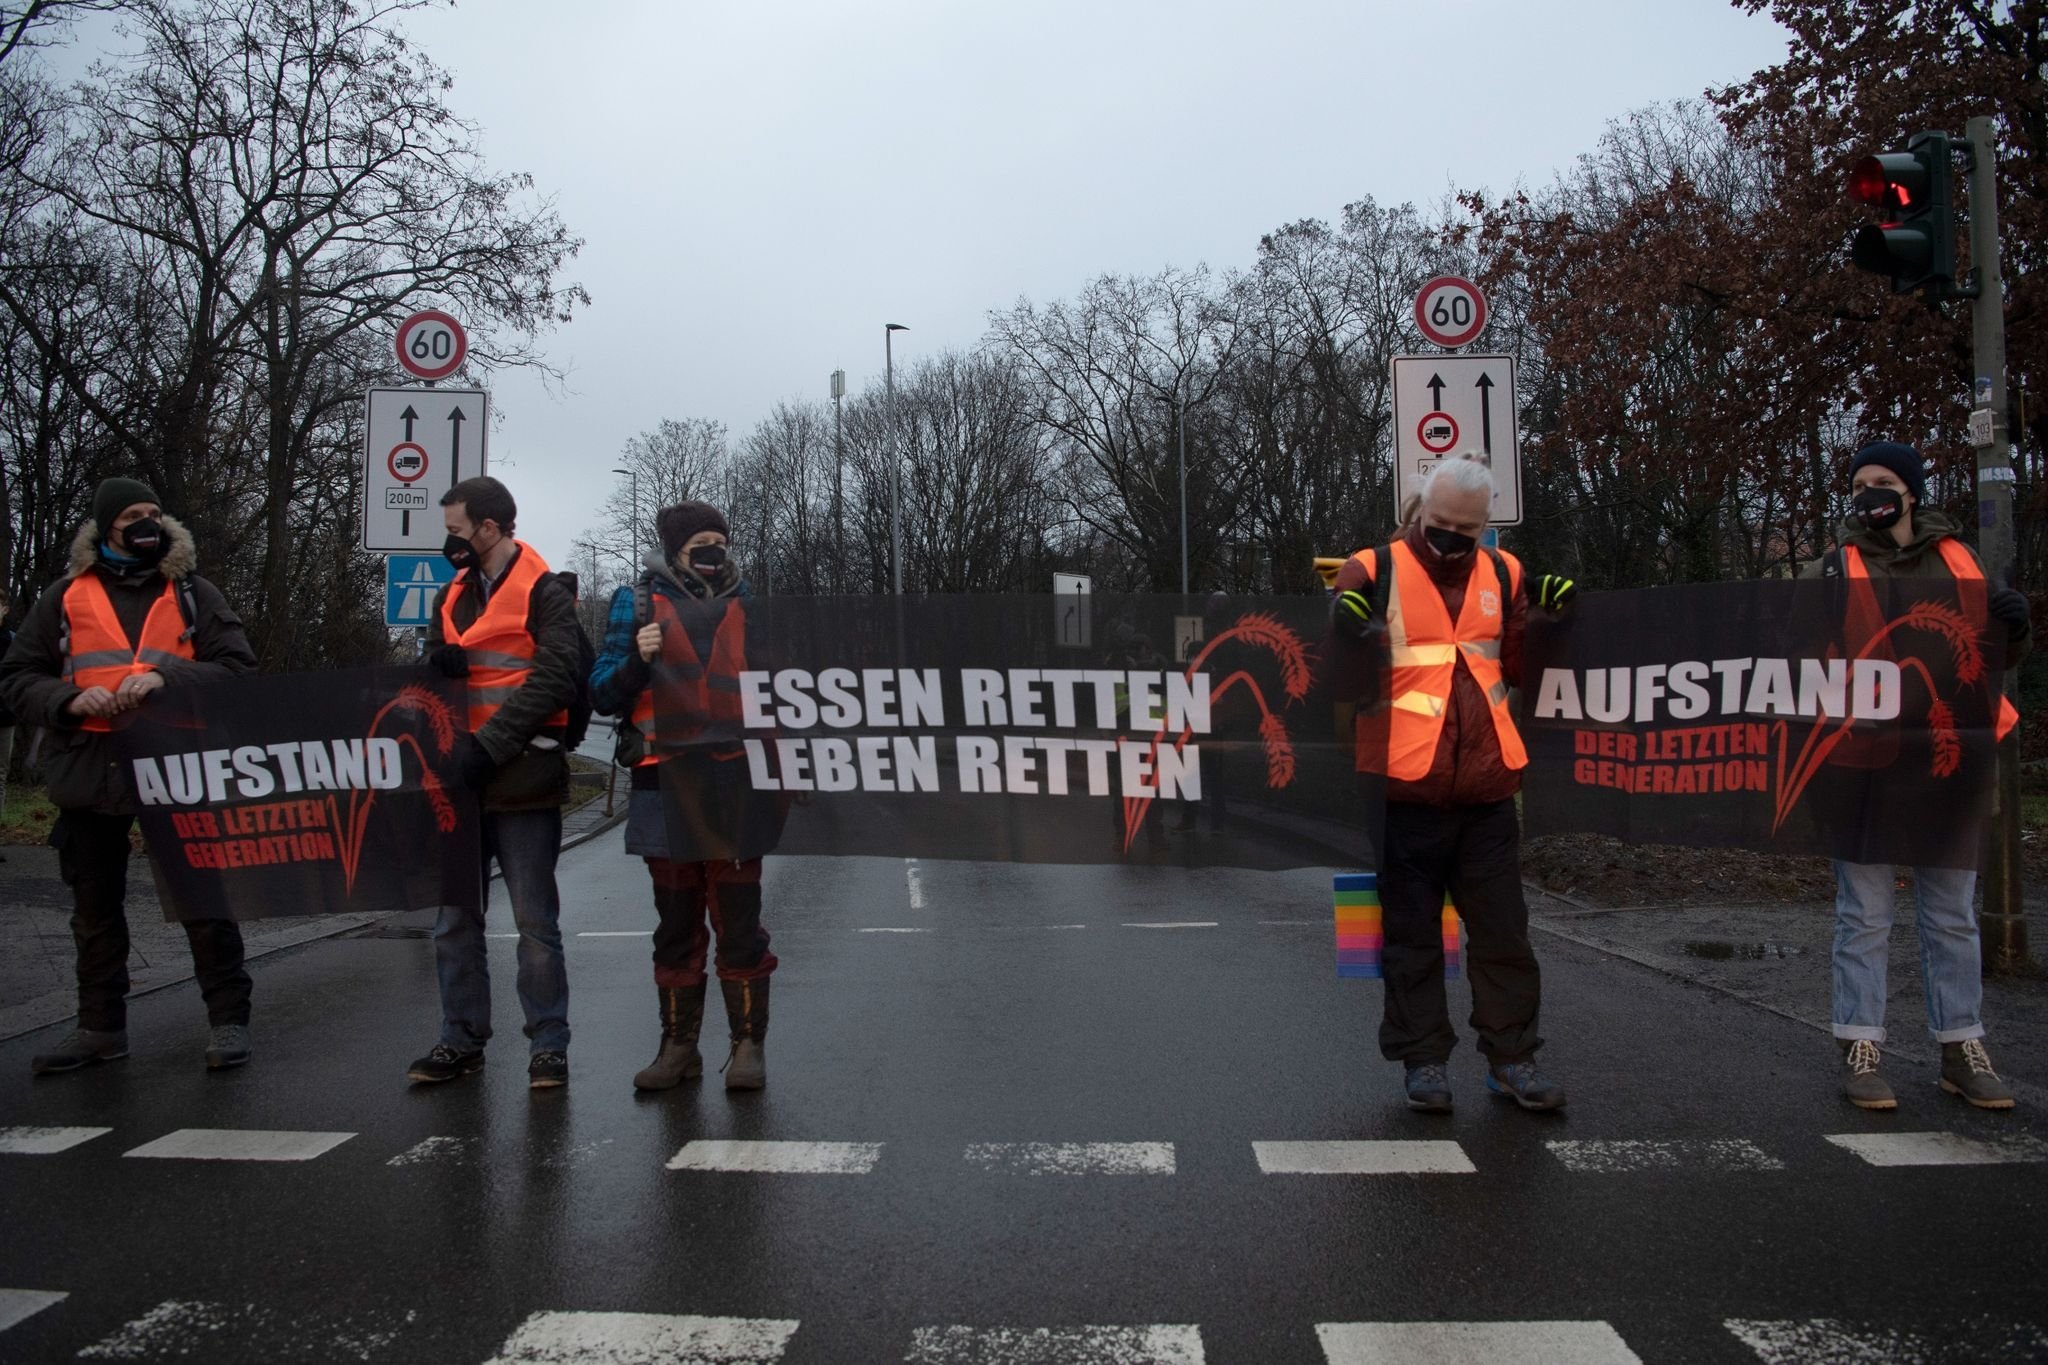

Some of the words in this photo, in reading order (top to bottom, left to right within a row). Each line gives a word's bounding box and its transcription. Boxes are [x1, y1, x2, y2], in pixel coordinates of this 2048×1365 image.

[1431, 296, 1470, 326] 60
[411, 330, 450, 359] 60
[739, 668, 944, 729] ESSEN
[961, 668, 1211, 734] RETTEN
[1535, 657, 1901, 723] AUFSTAND
[1574, 731, 1637, 762] DER
[1645, 723, 1768, 760] LETZTEN
[133, 737, 403, 805] AUFSTAND
[743, 736, 940, 792] LEBEN
[956, 736, 1202, 802] RETTEN
[1573, 759, 1768, 794] GENERATION
[172, 811, 219, 839] DER
[222, 799, 328, 836] LETZTEN
[184, 832, 335, 869] GENERATION
